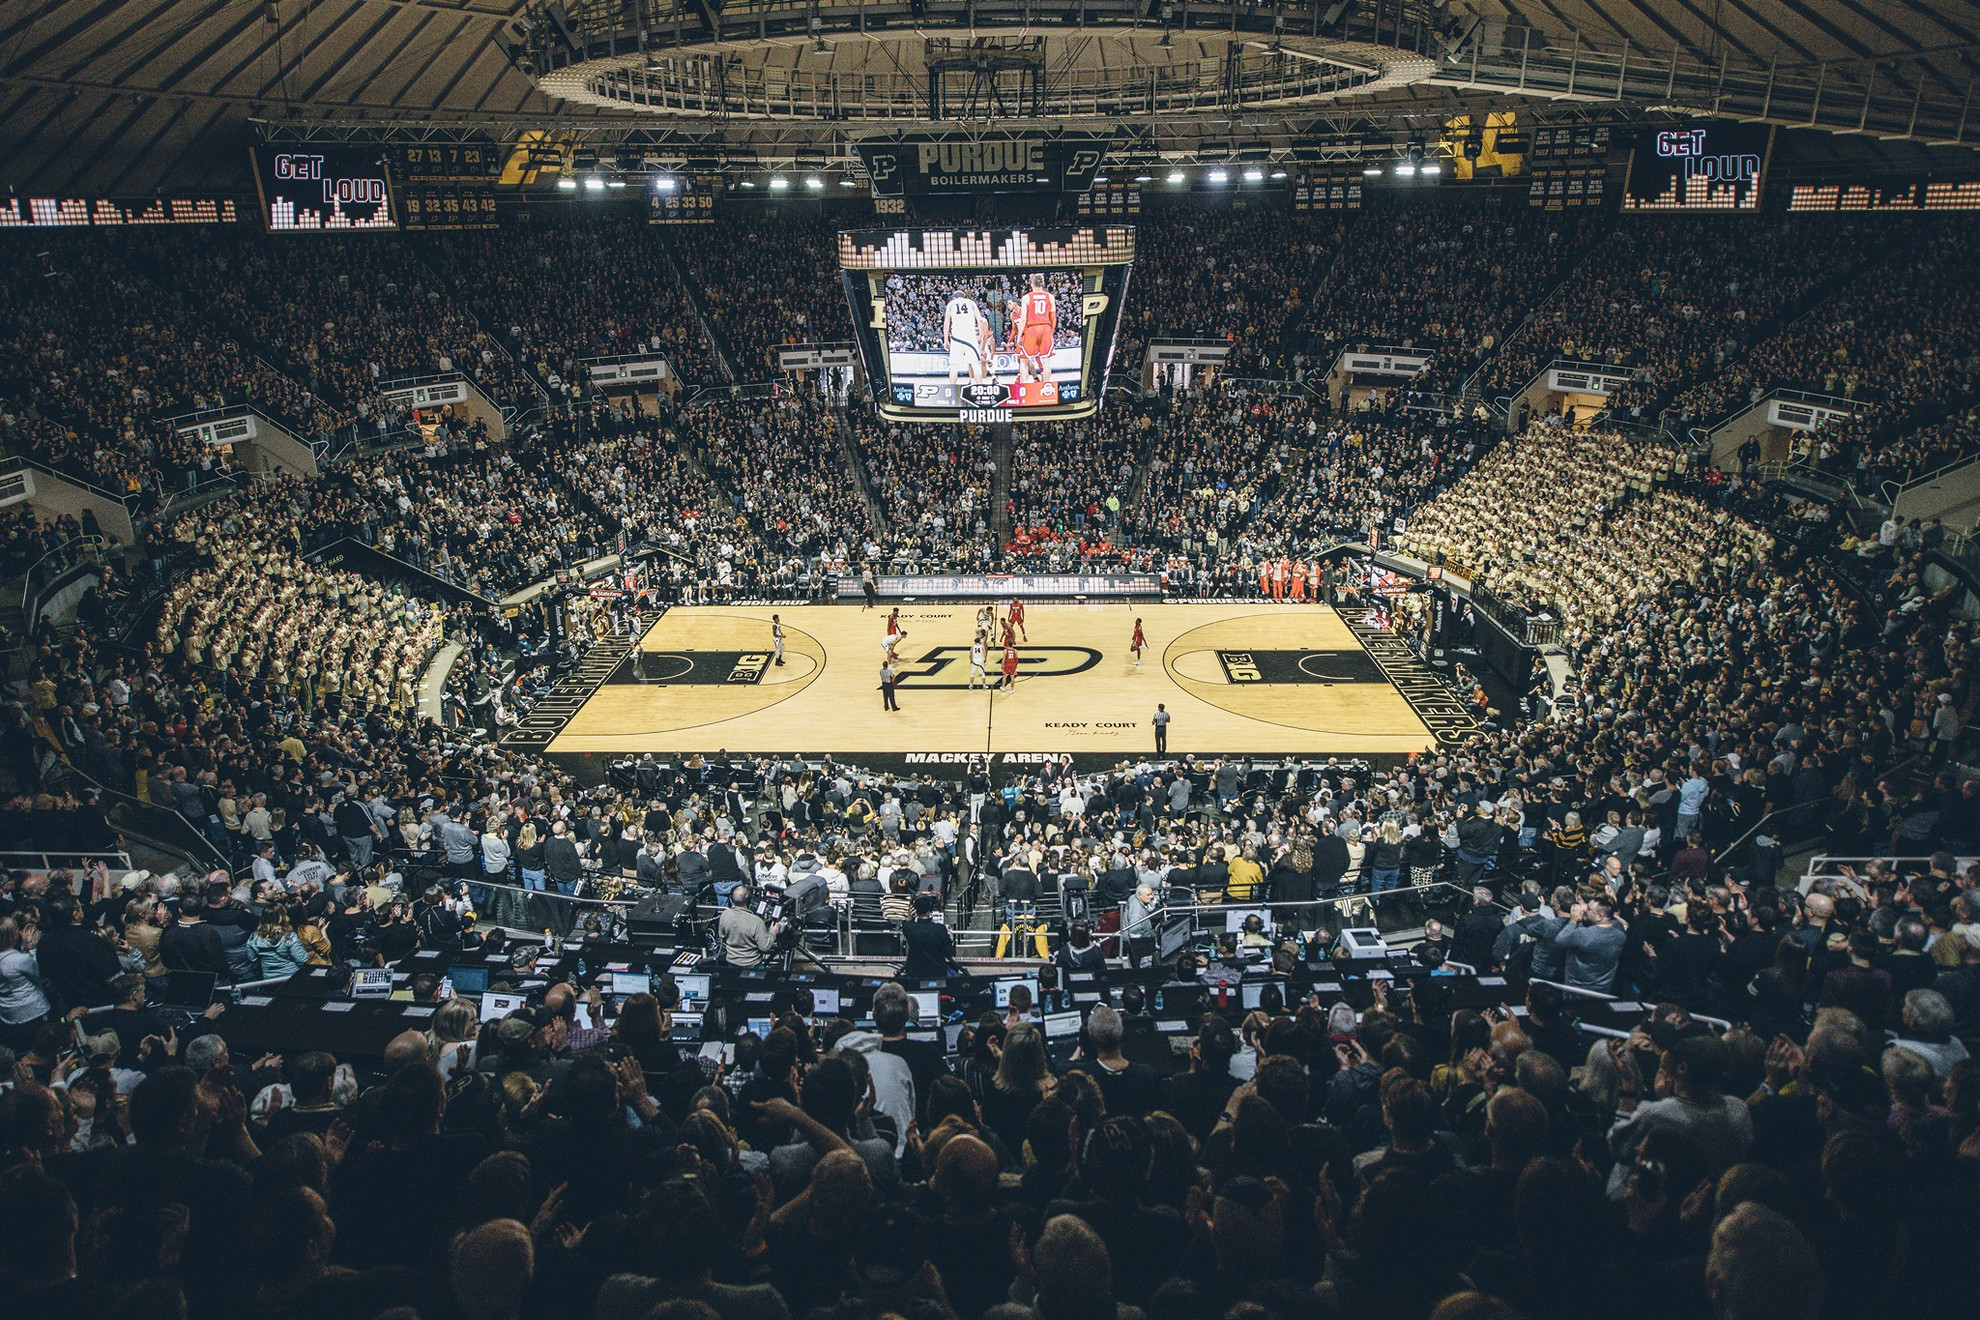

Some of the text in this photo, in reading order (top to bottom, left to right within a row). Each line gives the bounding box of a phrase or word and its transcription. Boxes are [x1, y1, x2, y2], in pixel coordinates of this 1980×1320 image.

[1657, 129, 1706, 156] GET
[407, 150, 423, 162] 27
[428, 150, 441, 162] 13
[450, 150, 457, 162] 7
[465, 151, 479, 163] 23
[918, 139, 1044, 173] PURDUE
[275, 154, 324, 179] GET
[931, 174, 1034, 185] BOILERMAKERS
[323, 179, 384, 203] LOUD
[406, 200, 419, 212] 19
[425, 199, 441, 212] 32
[444, 199, 459, 212] 35
[463, 199, 477, 211] 43
[481, 199, 496, 211] 42
[652, 197, 659, 208] 4
[665, 197, 679, 208] 25
[682, 197, 696, 208] 33
[699, 197, 712, 208] 50
[874, 200, 905, 213] 1932
[956, 303, 968, 314] 14
[1034, 300, 1046, 314] 10
[893, 386, 914, 394] Anthem
[945, 388, 951, 397] 0
[971, 385, 999, 396] 20:00
[1019, 386, 1026, 397] 0
[960, 409, 1012, 423] PURDUE
[906, 753, 1074, 763] MACKEY ARENA
[296, 865, 322, 876] LANDMARK
